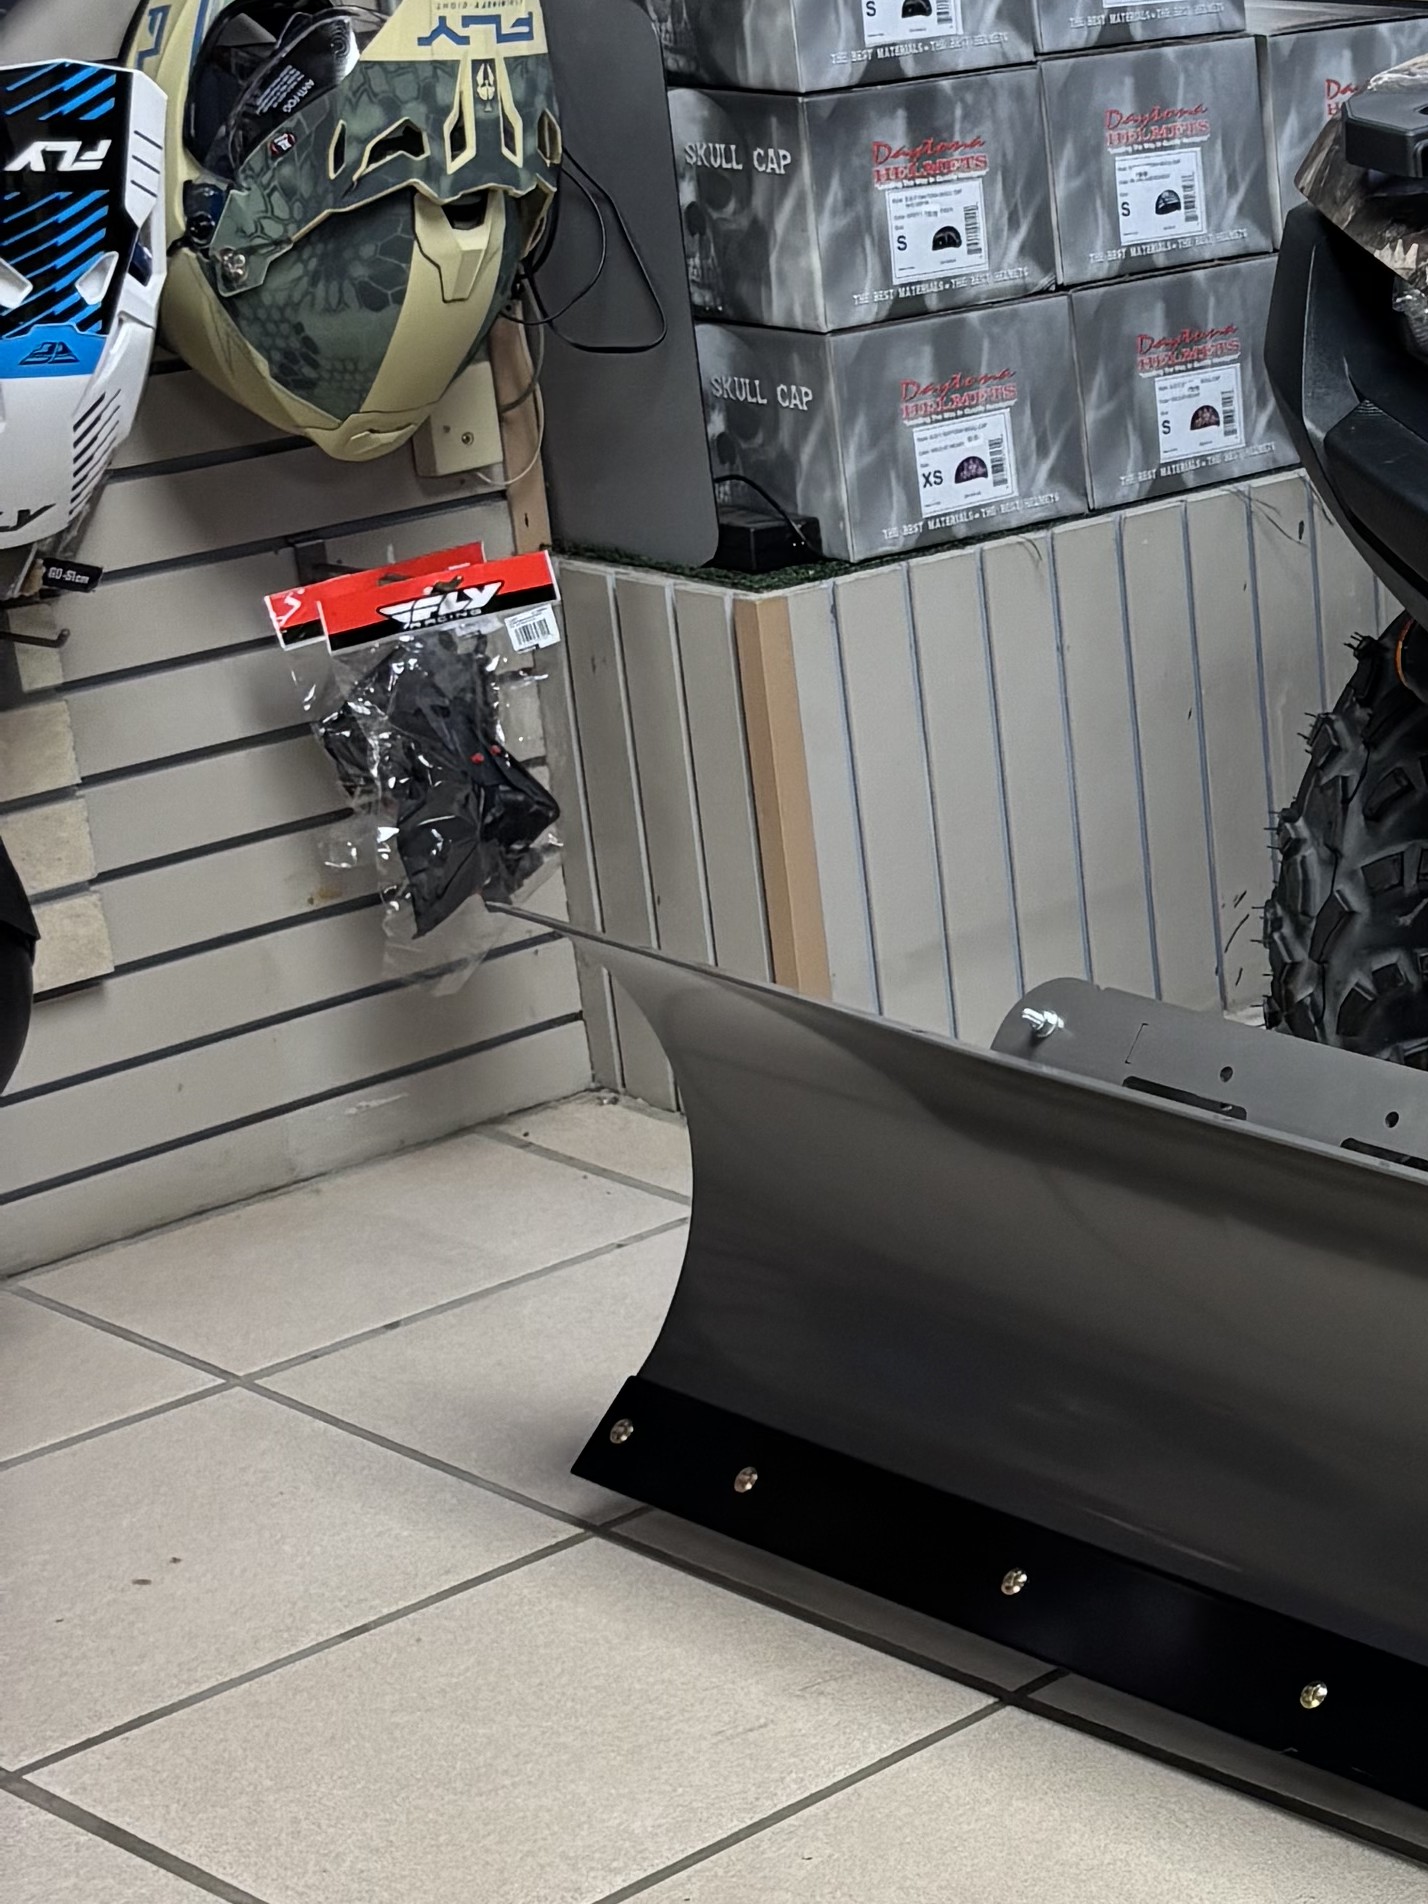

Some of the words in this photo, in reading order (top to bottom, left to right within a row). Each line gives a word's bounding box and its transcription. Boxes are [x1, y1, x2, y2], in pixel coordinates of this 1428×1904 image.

[866, 1, 876, 17] S
[417, 11, 534, 46] FLY
[3, 139, 112, 172] FLY
[684, 142, 743, 171] SKULL
[753, 148, 792, 174] CAP
[1121, 202, 1130, 217] S
[897, 235, 908, 251] S
[710, 376, 767, 405] SKULL
[776, 384, 813, 411] CAP
[1162, 420, 1171, 434] S
[922, 471, 943, 488] XS
[379, 581, 502, 623] FLY
[403, 608, 482, 630] RACING
